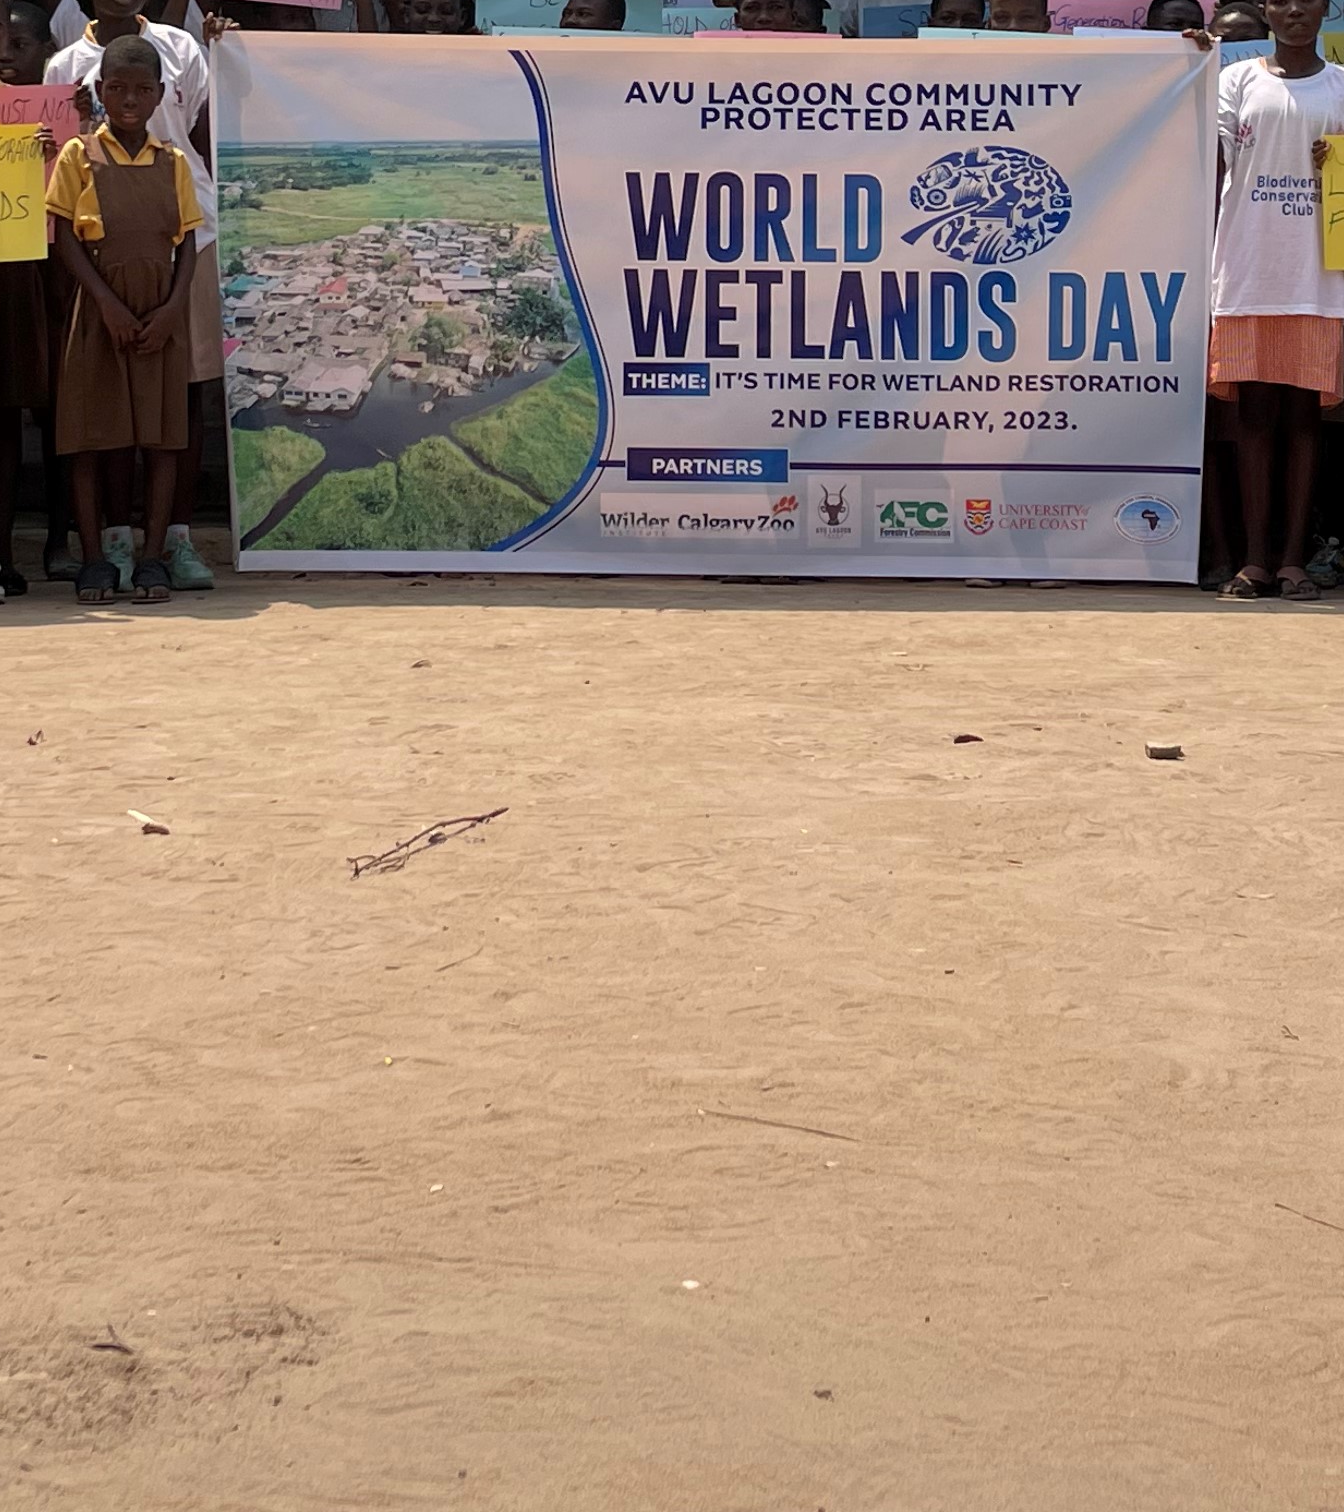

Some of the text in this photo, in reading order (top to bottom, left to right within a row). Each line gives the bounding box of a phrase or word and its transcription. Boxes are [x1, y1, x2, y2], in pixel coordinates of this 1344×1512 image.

[624, 81, 1083, 107] AVU LAGOON COMMUNITY
[42, 97, 75, 124] NOT
[700, 107, 1015, 132] PROTECTED AREA
[624, 172, 883, 262] WORLD
[1282, 202, 1314, 216] Club
[623, 269, 1187, 362] WETLANDS DAY
[627, 372, 1179, 393] THEME: IT'S TIME FOR WETLAND RESTORATION
[770, 409, 1078, 434] 2ND FEBRUARY, 2023.
[652, 457, 763, 476] PARTNERS
[999, 504, 1082, 516] UNIVERSITY
[600, 512, 794, 533] Wilder Calgary Zoo
[998, 518, 1088, 531] CAPE COAST
